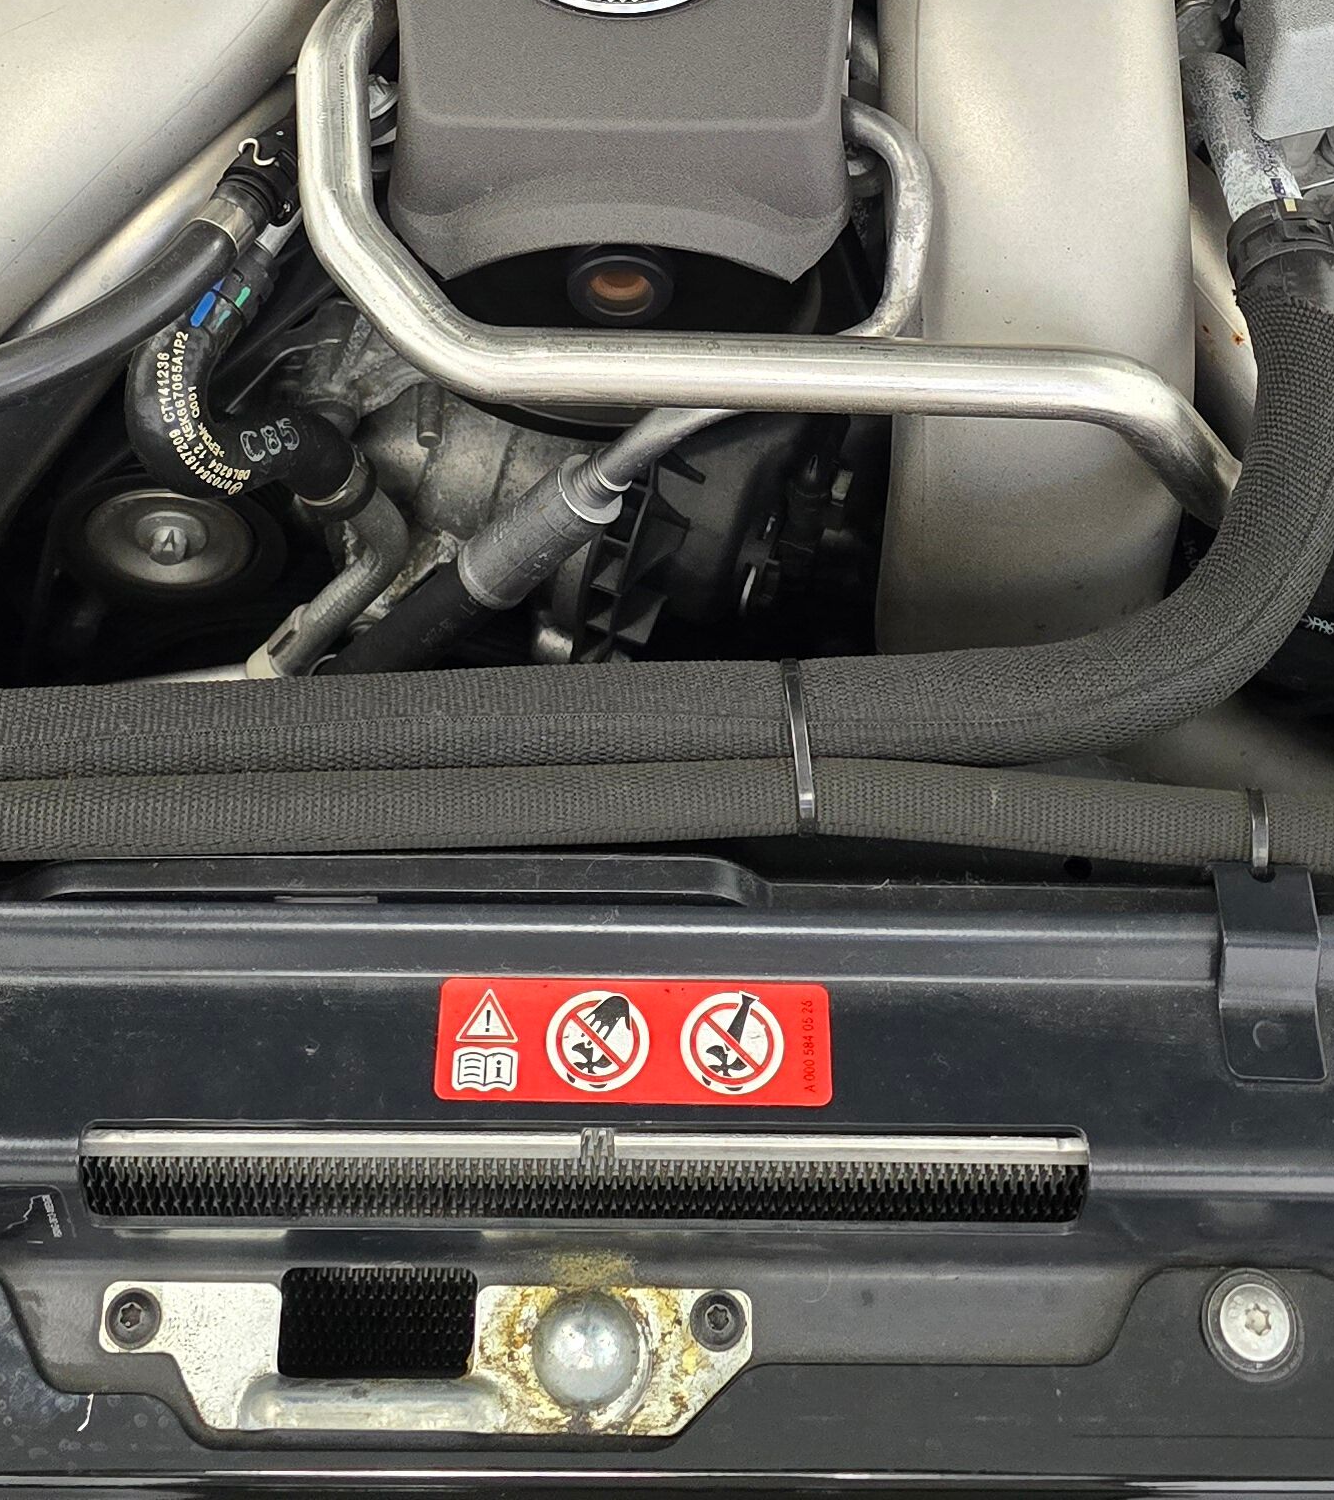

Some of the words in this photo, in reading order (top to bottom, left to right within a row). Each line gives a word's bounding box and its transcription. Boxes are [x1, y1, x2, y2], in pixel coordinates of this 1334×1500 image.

[240, 417, 300, 462] C85
[801, 1000, 813, 1014] 26
[801, 1017, 814, 1031] 05
[802, 1035, 814, 1056] 584
[803, 1059, 816, 1081] 000
[804, 1085, 816, 1093] A
